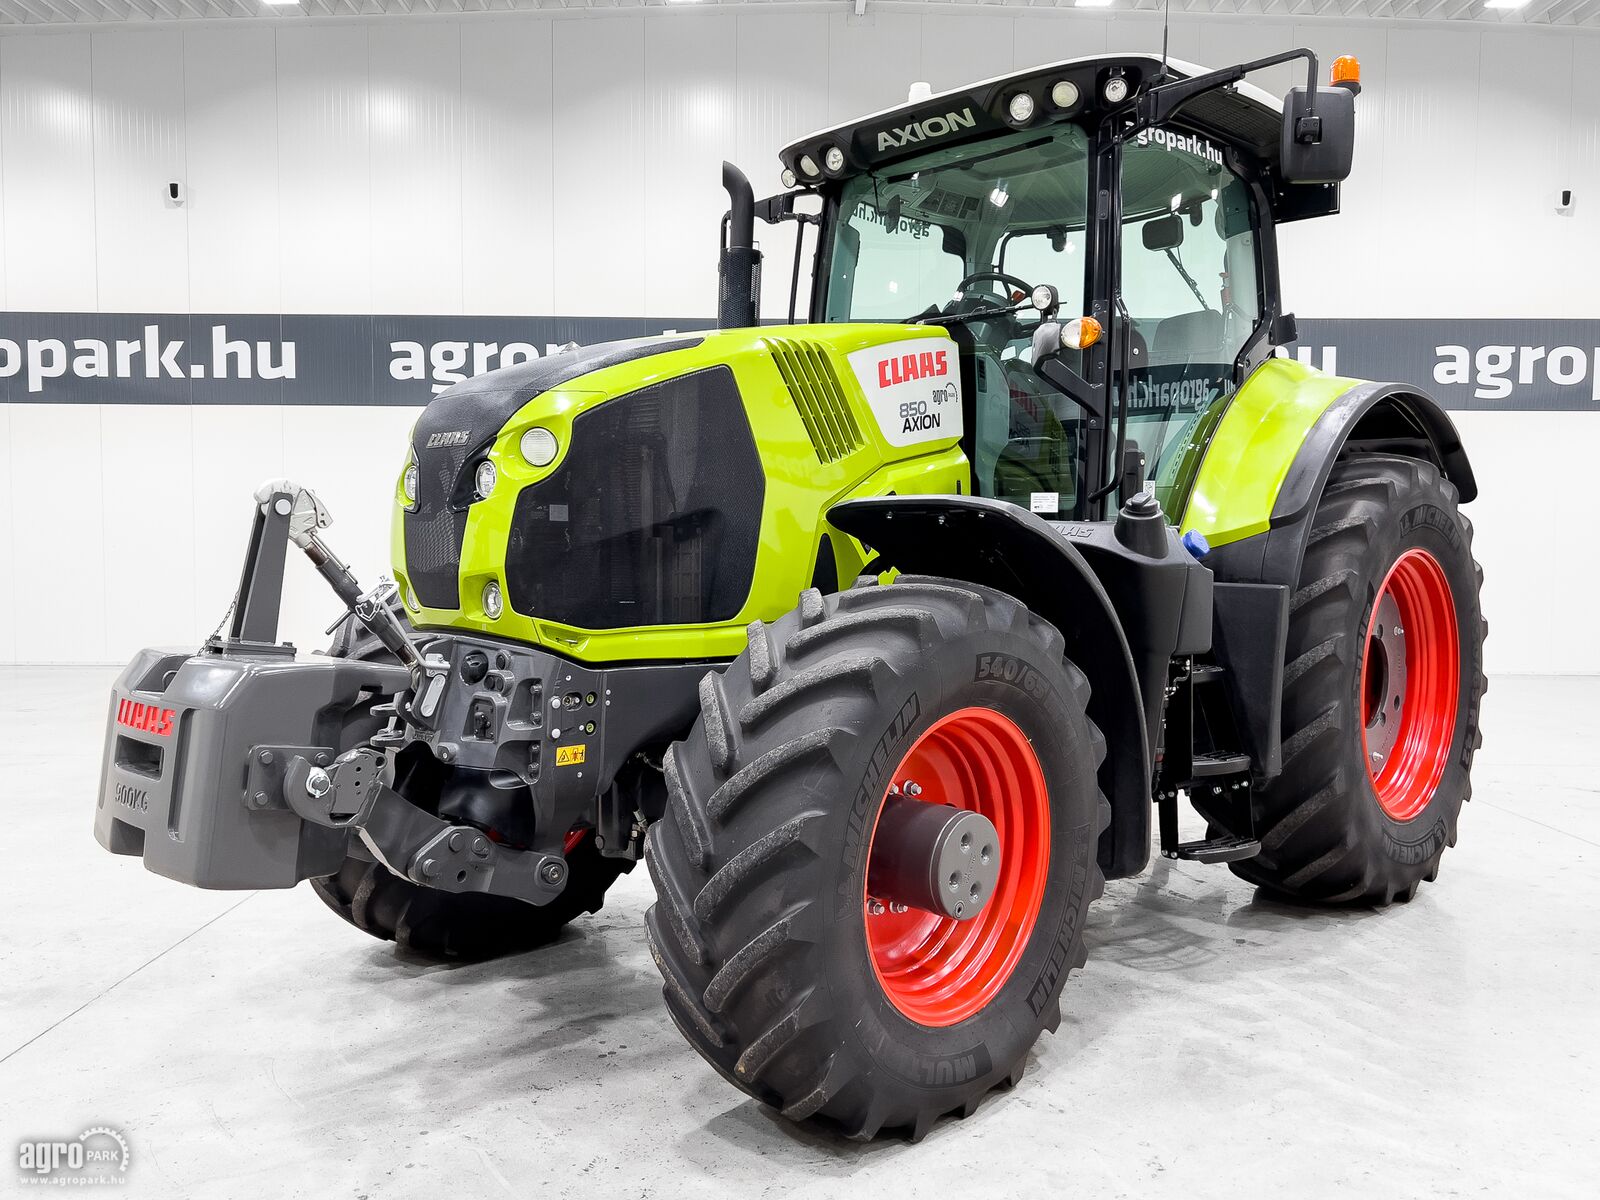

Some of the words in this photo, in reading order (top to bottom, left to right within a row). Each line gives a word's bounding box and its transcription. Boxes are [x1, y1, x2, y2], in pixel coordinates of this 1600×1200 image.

[877, 107, 976, 152] AXION
[389, 340, 568, 394] agro
[877, 350, 948, 389] CLAAS
[1433, 345, 1600, 401] agro
[900, 400, 927, 418] 850
[902, 413, 941, 433] AXION
[425, 430, 472, 449] CLAAS
[1055, 525, 1094, 538] AAS
